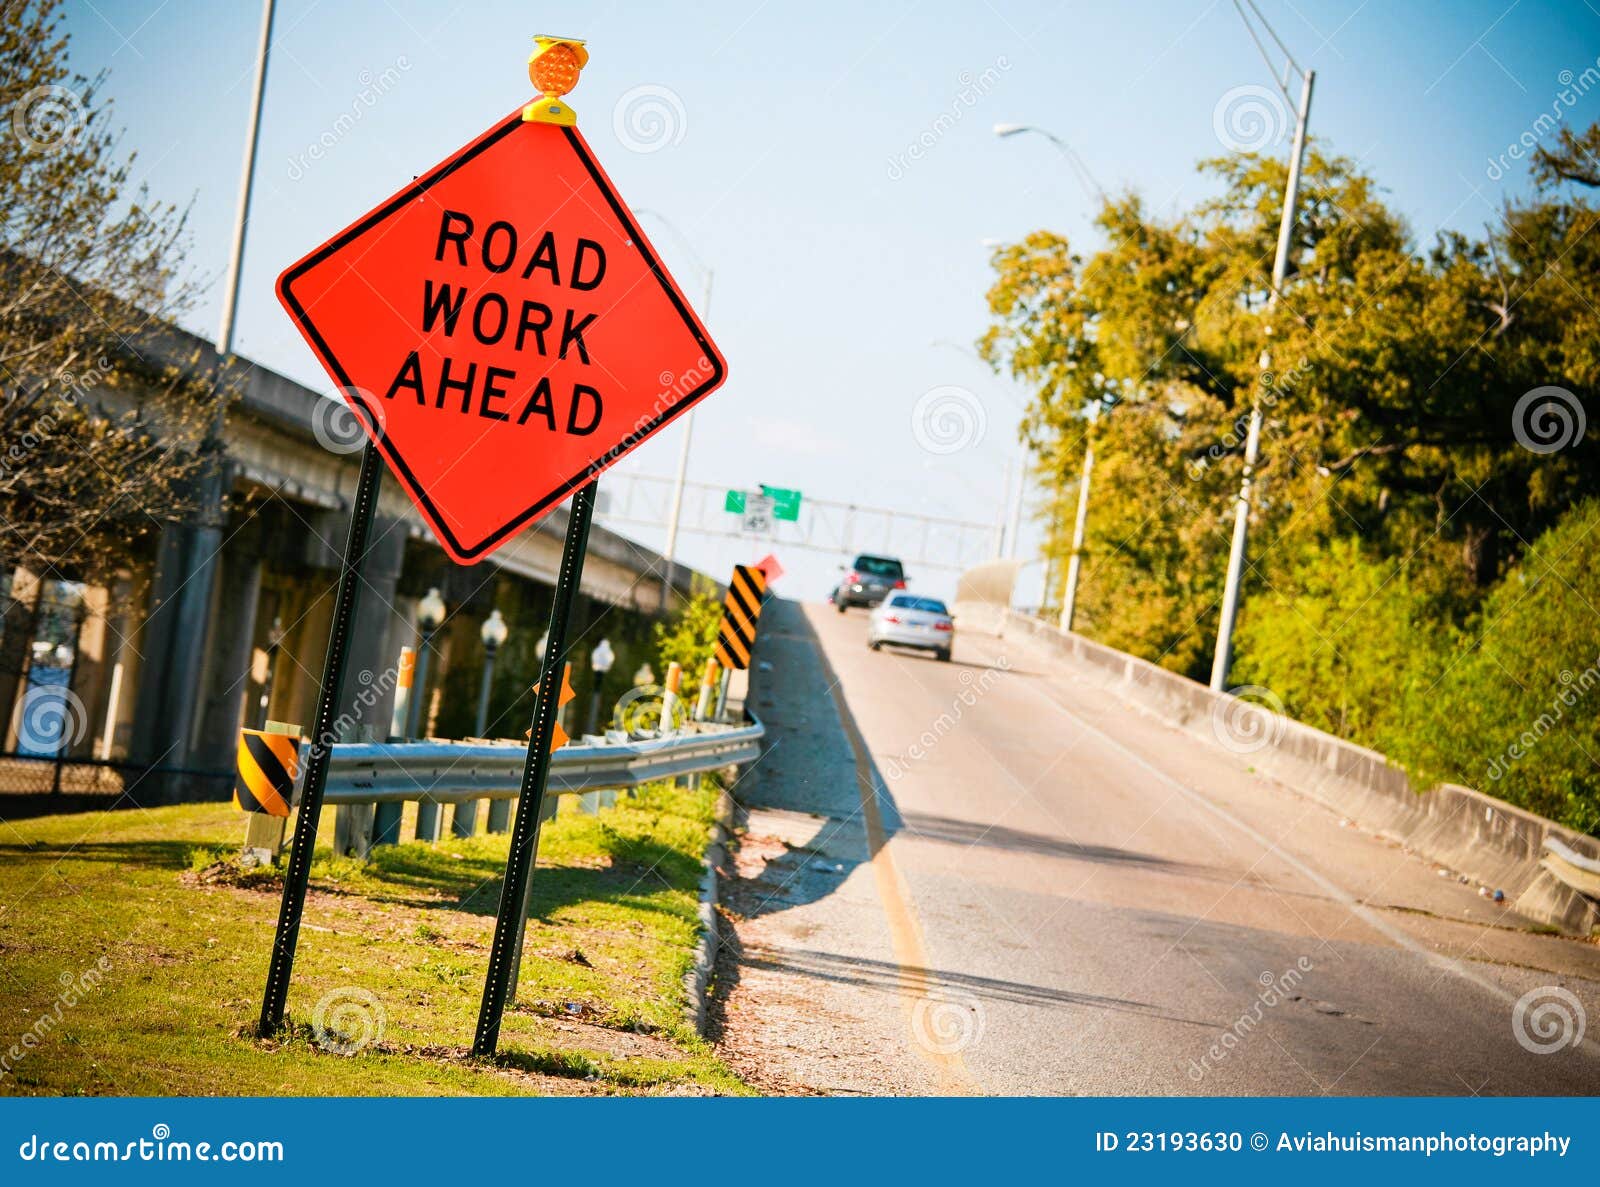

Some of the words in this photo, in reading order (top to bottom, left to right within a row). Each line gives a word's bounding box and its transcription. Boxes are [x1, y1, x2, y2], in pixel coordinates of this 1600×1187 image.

[435, 209, 607, 291] ROAD
[422, 280, 599, 365] WORK
[385, 351, 603, 437] AHEAD
